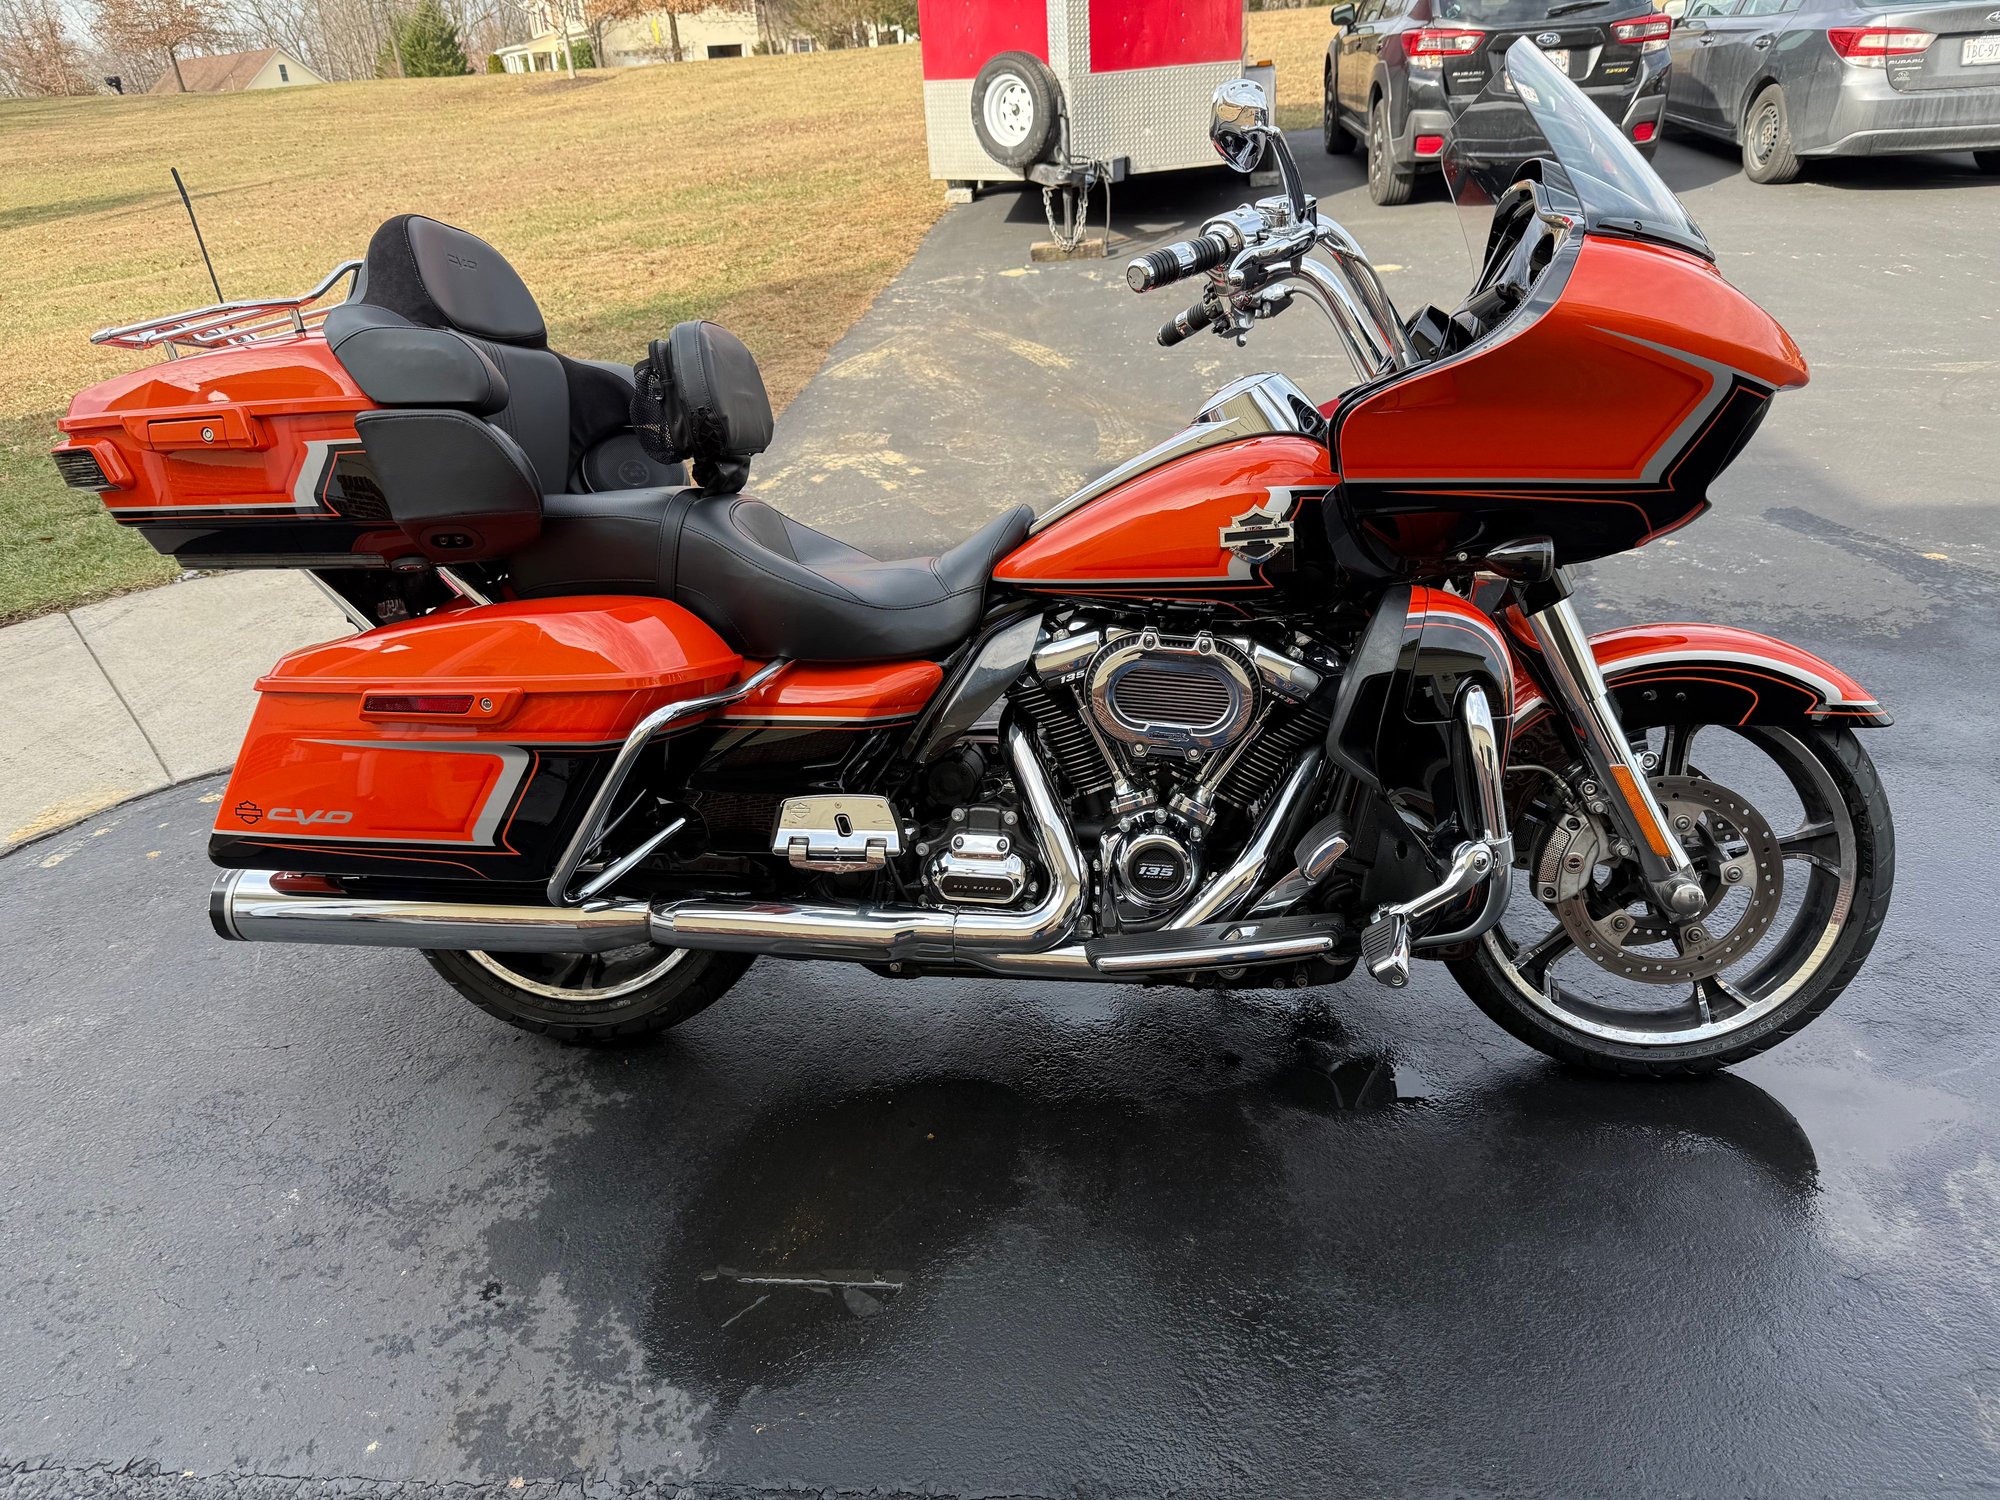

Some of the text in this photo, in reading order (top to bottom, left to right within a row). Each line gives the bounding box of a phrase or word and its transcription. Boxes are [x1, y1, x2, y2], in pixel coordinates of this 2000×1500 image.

[1888, 57, 1925, 65] SUBARU
[1061, 670, 1085, 684] 135
[267, 807, 353, 825] CVO
[1138, 866, 1174, 877] 135
